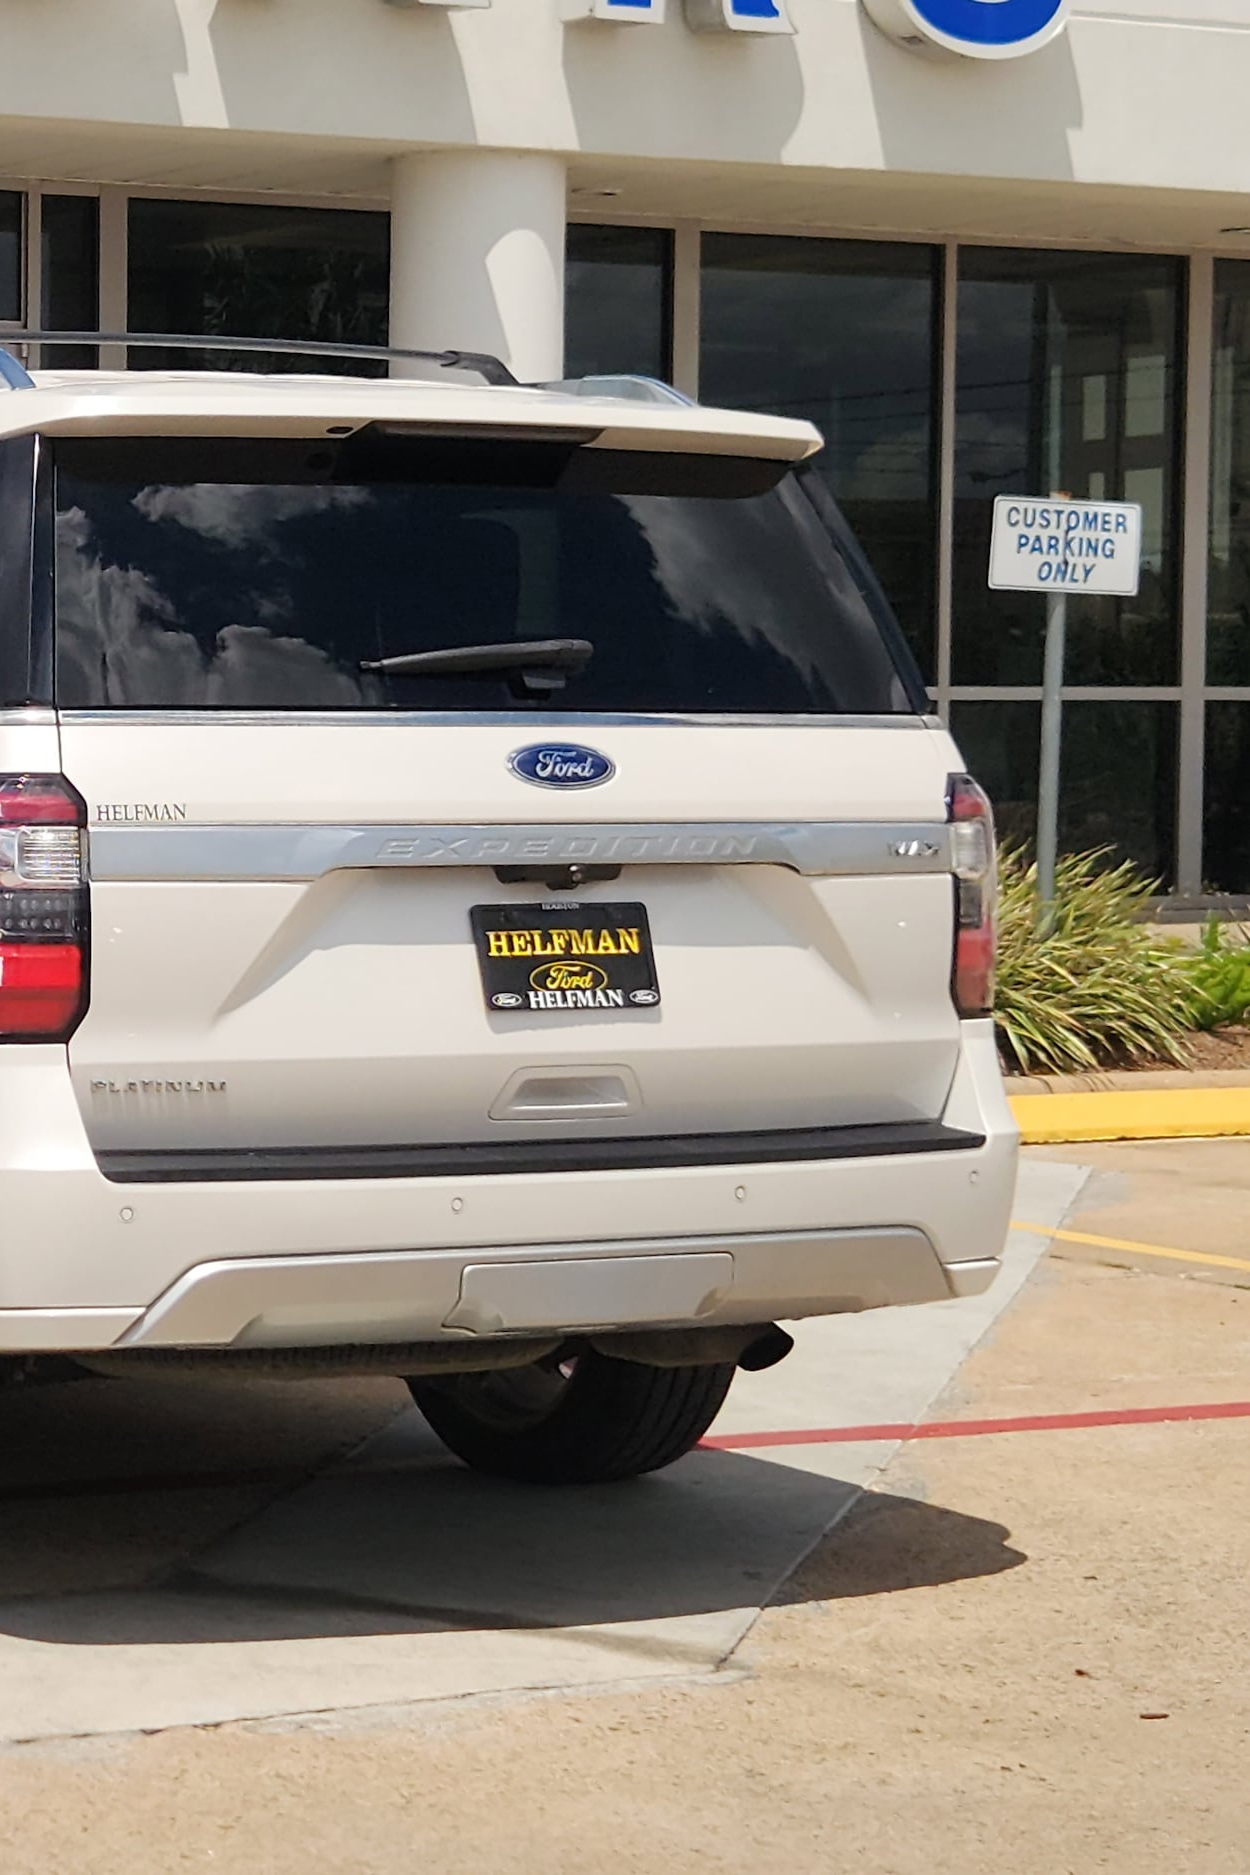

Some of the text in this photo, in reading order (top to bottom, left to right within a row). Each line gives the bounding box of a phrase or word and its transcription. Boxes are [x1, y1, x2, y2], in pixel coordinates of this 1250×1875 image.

[1007, 506, 1128, 534] CUSTOMER
[1016, 533, 1116, 560] PARKING
[1037, 560, 1097, 585] ONLY
[96, 802, 188, 822] HELFMAN
[376, 835, 759, 860] EXPEDITION
[484, 928, 641, 958] HELFMAN
[545, 964, 594, 990] Ford
[527, 989, 626, 1009] HELFMAN
[90, 1078, 227, 1095] PLATINUM
